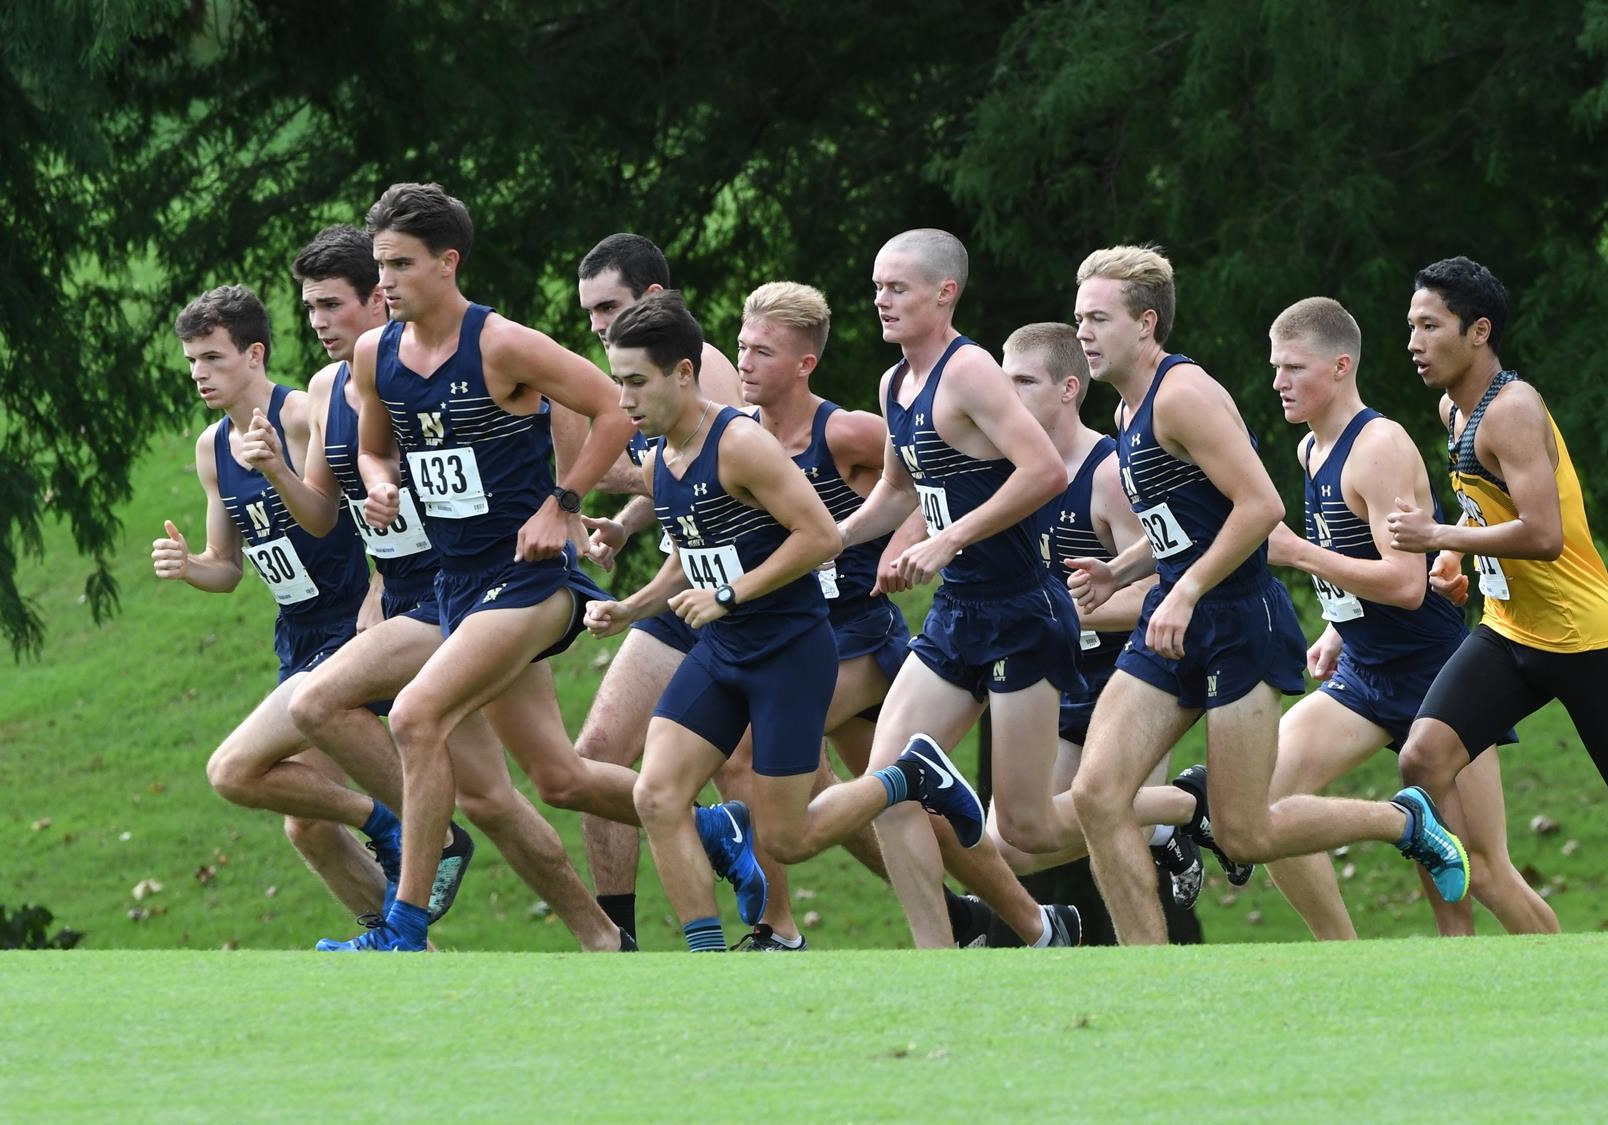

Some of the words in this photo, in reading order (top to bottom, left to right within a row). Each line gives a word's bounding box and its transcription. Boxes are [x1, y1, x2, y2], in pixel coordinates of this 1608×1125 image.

[417, 412, 444, 438] N
[900, 445, 922, 473] N
[421, 455, 467, 495] 433
[1122, 467, 1138, 496] N
[245, 501, 270, 530] N
[918, 491, 945, 531] 40
[677, 515, 701, 540] N
[1141, 513, 1179, 553] 32
[1313, 512, 1332, 540] N
[688, 554, 729, 589] 441
